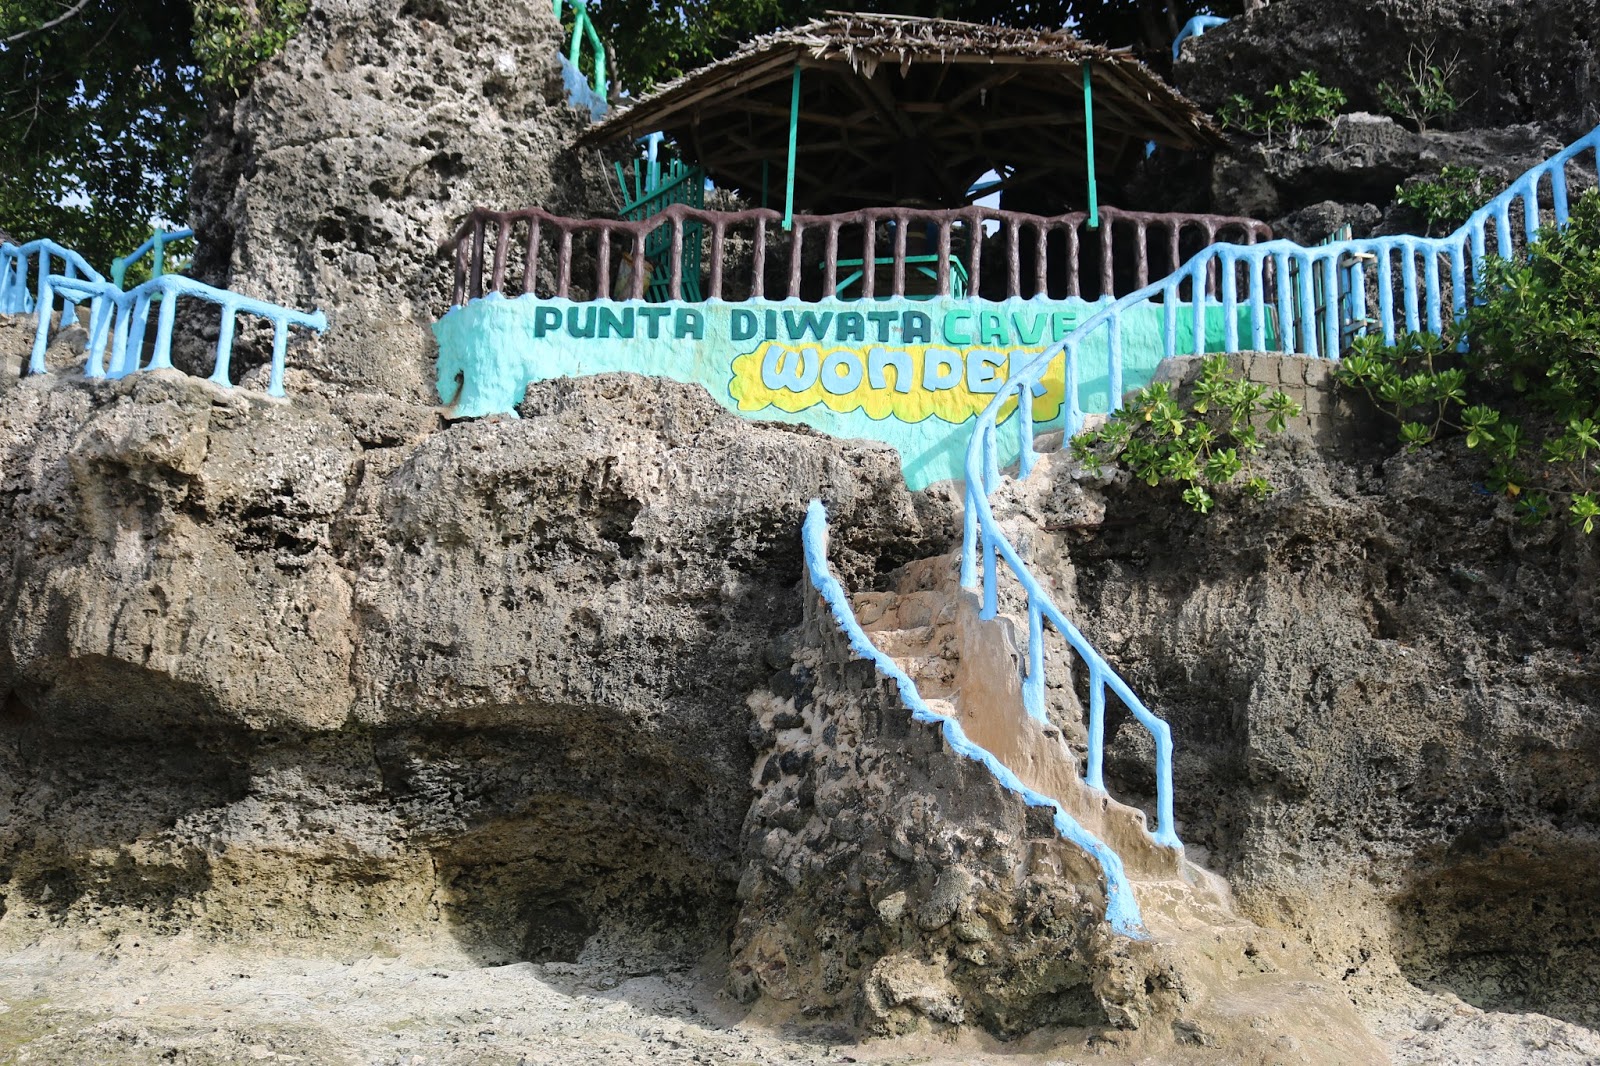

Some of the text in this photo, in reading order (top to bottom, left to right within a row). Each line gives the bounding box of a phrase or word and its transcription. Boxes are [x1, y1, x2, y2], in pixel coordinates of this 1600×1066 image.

[534, 306, 1076, 344] PUNTA DIWATA CAVE
